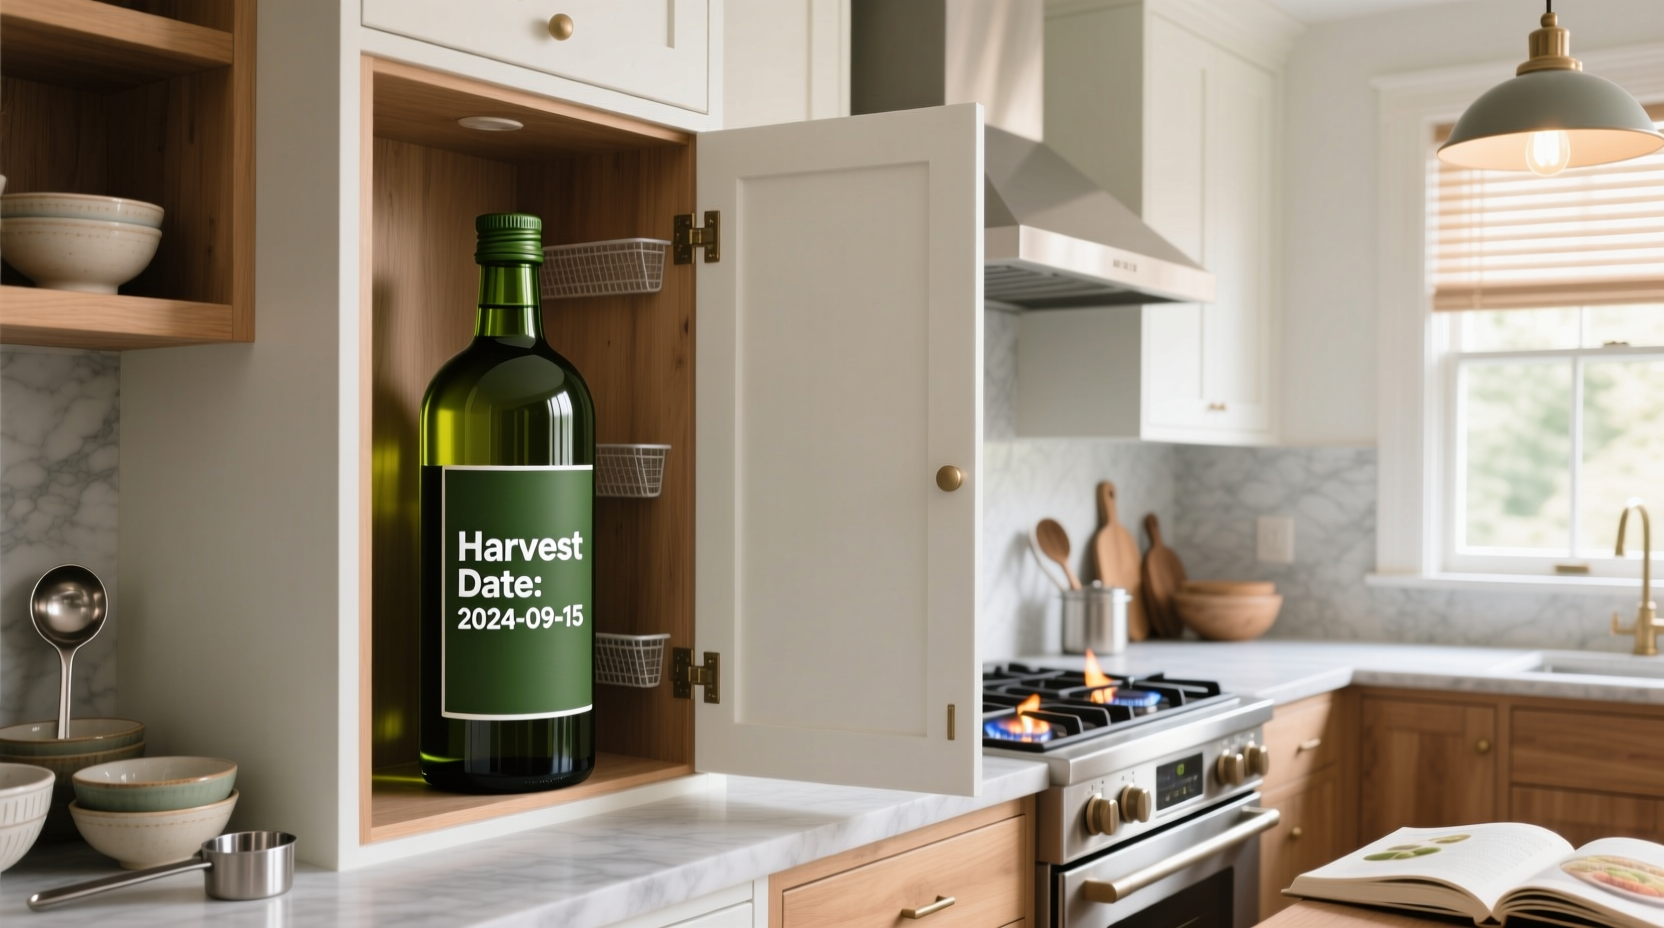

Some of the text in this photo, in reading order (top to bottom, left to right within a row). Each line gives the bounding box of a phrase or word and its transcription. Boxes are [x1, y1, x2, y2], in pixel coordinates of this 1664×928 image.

[458, 531, 584, 562] Harvest
[458, 568, 542, 598] Date:
[457, 604, 584, 630] 2024-09-15
